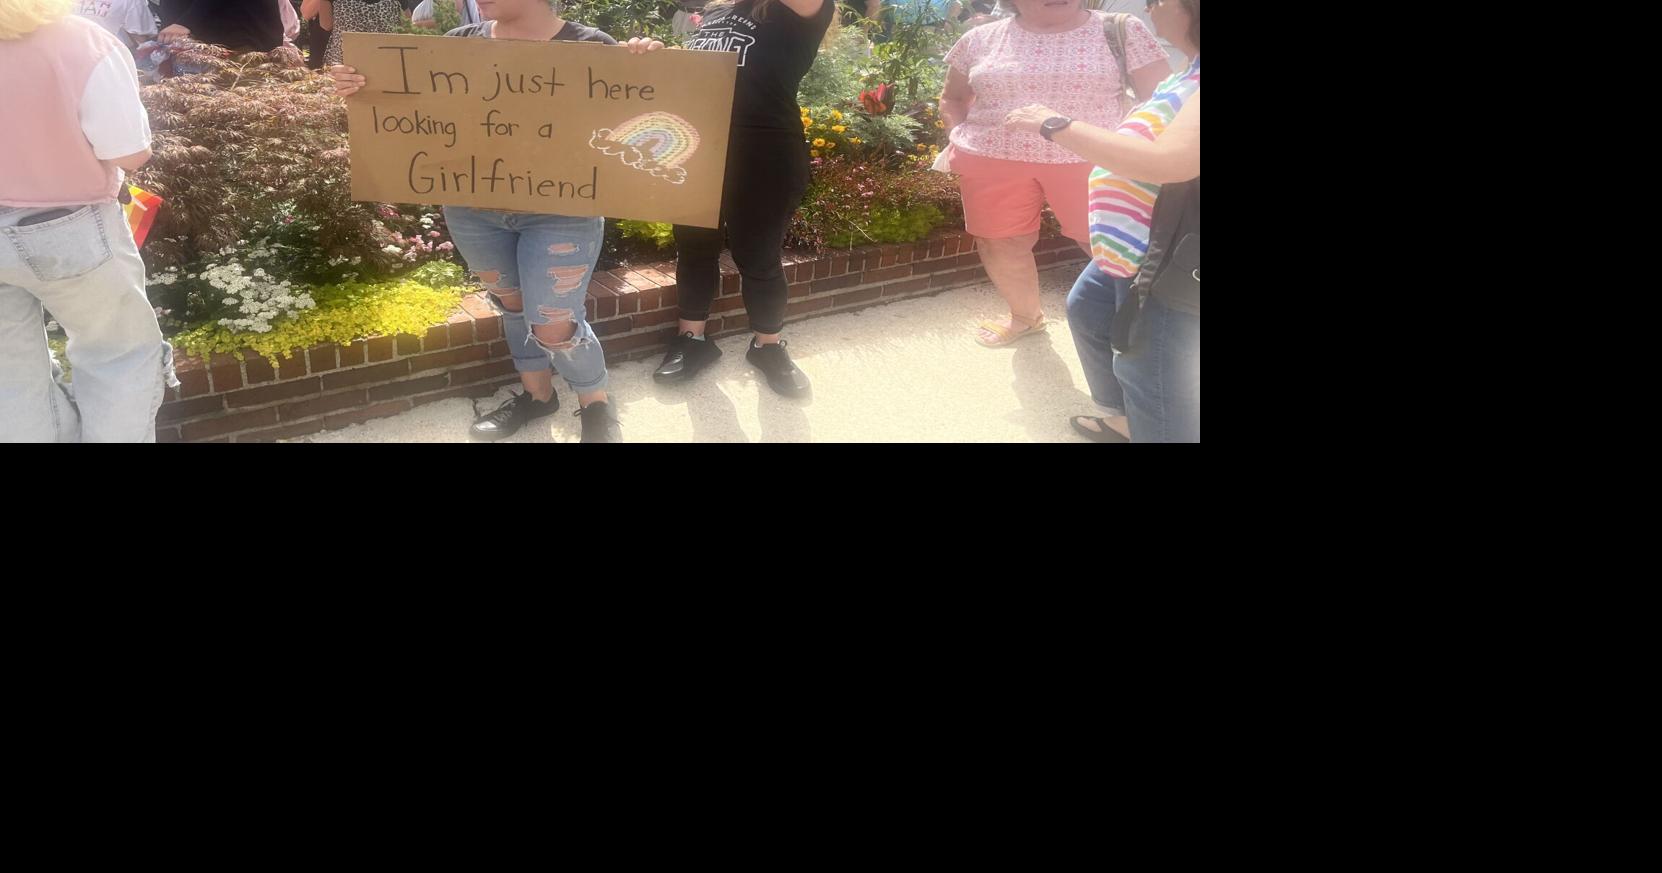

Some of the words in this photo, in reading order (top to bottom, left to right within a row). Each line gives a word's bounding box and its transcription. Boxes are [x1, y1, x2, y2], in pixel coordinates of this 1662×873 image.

[481, 63, 565, 102] just
[587, 66, 655, 101] here
[372, 105, 457, 149] looking
[480, 109, 520, 138] for
[537, 123, 553, 139] a
[408, 151, 598, 201] Girlfriend
